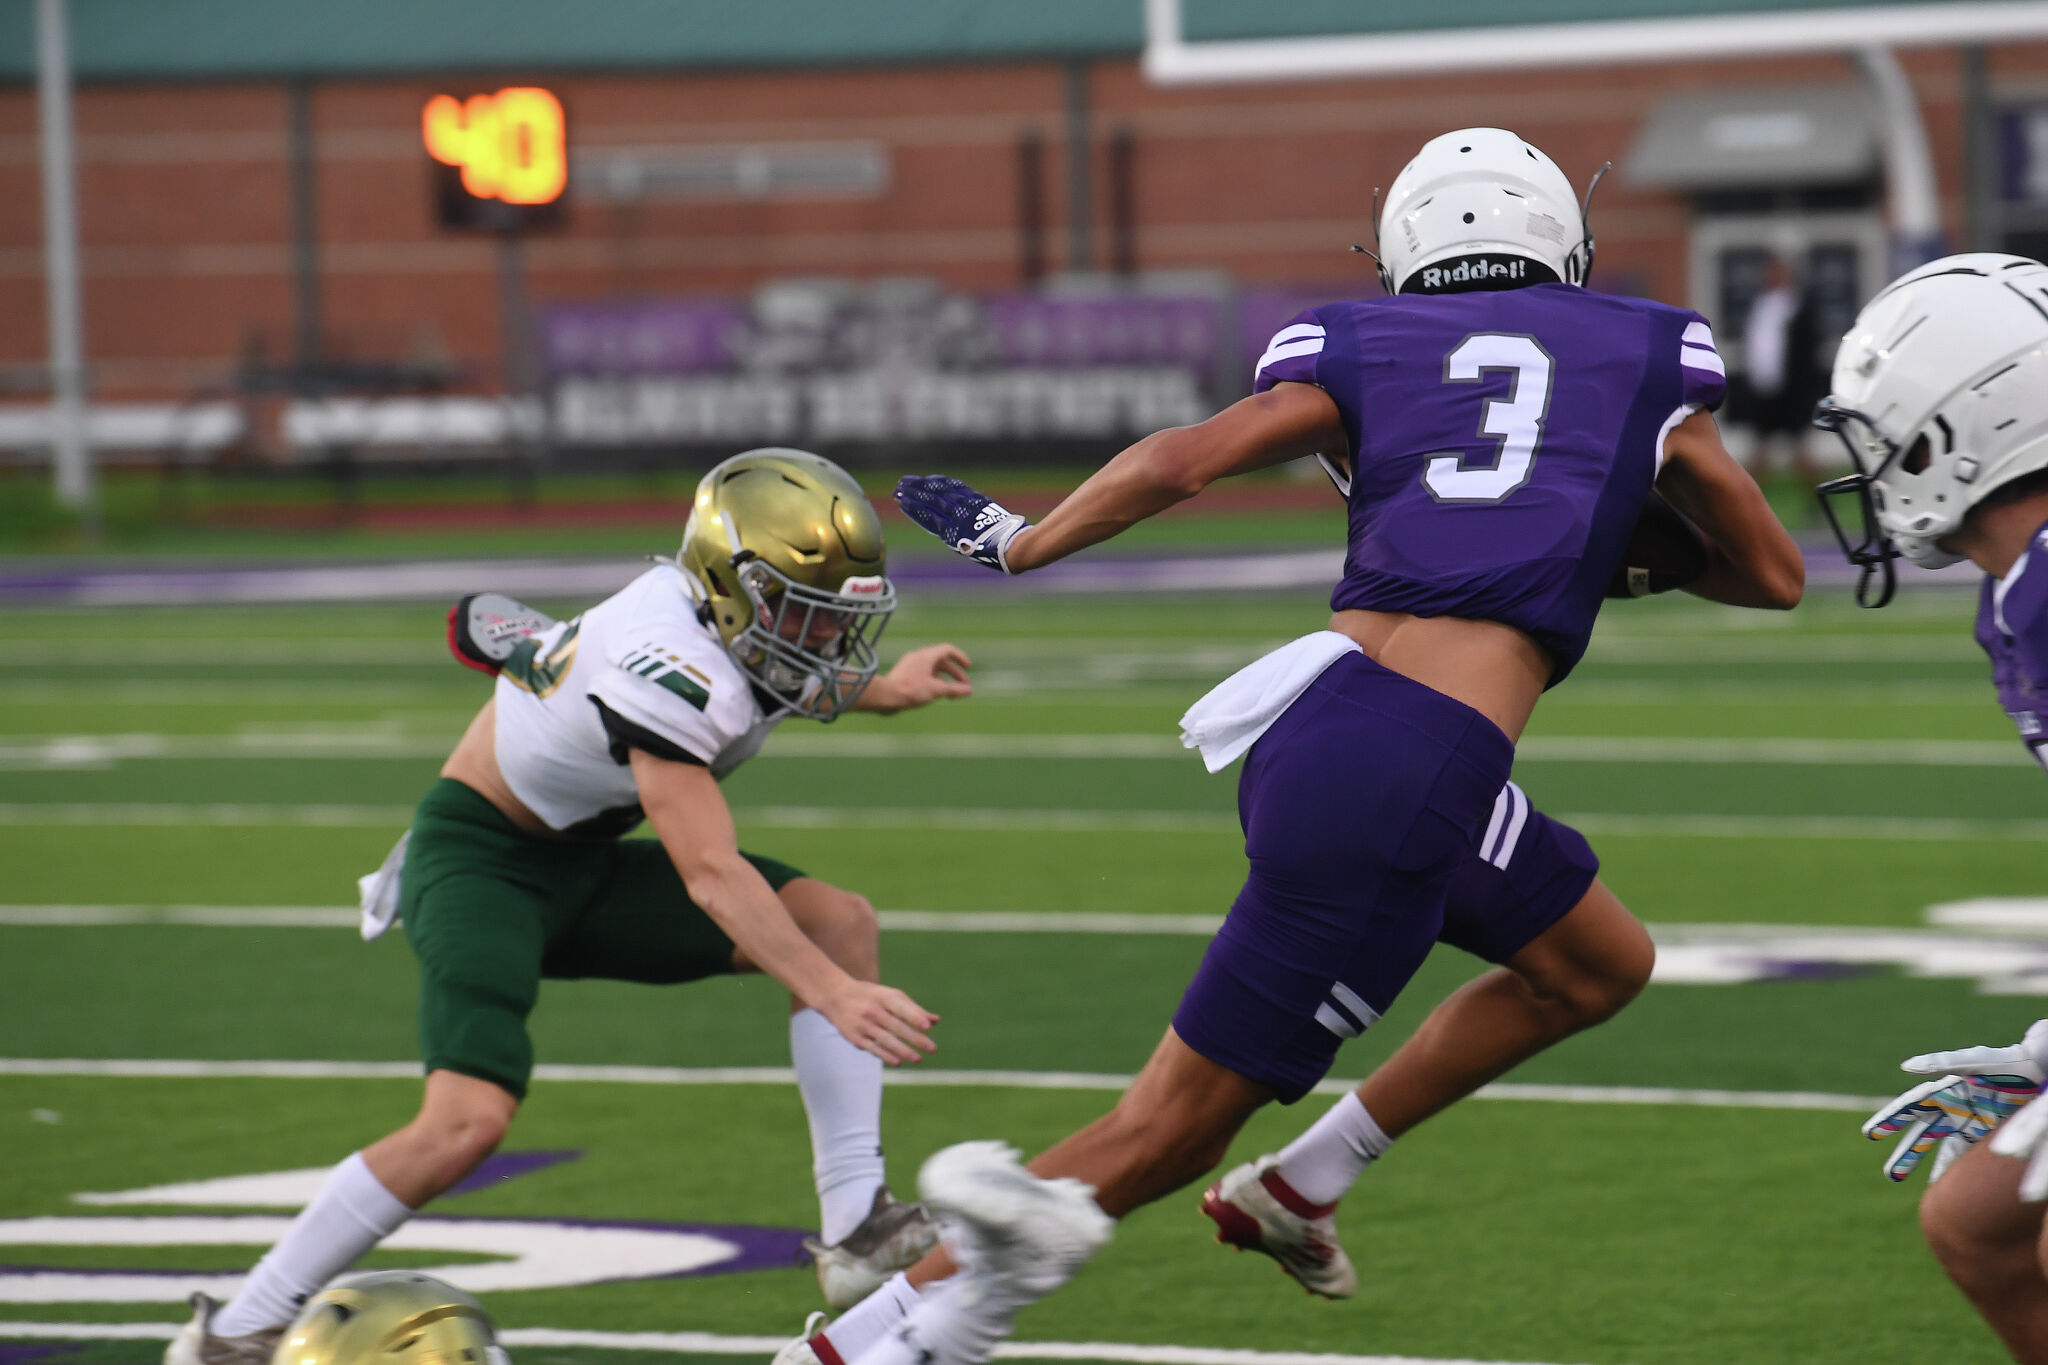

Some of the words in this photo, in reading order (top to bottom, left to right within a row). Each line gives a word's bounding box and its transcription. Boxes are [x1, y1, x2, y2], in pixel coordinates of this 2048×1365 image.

[423, 87, 567, 205] 40
[1422, 259, 1526, 289] Riddell
[1420, 331, 1556, 504] 3
